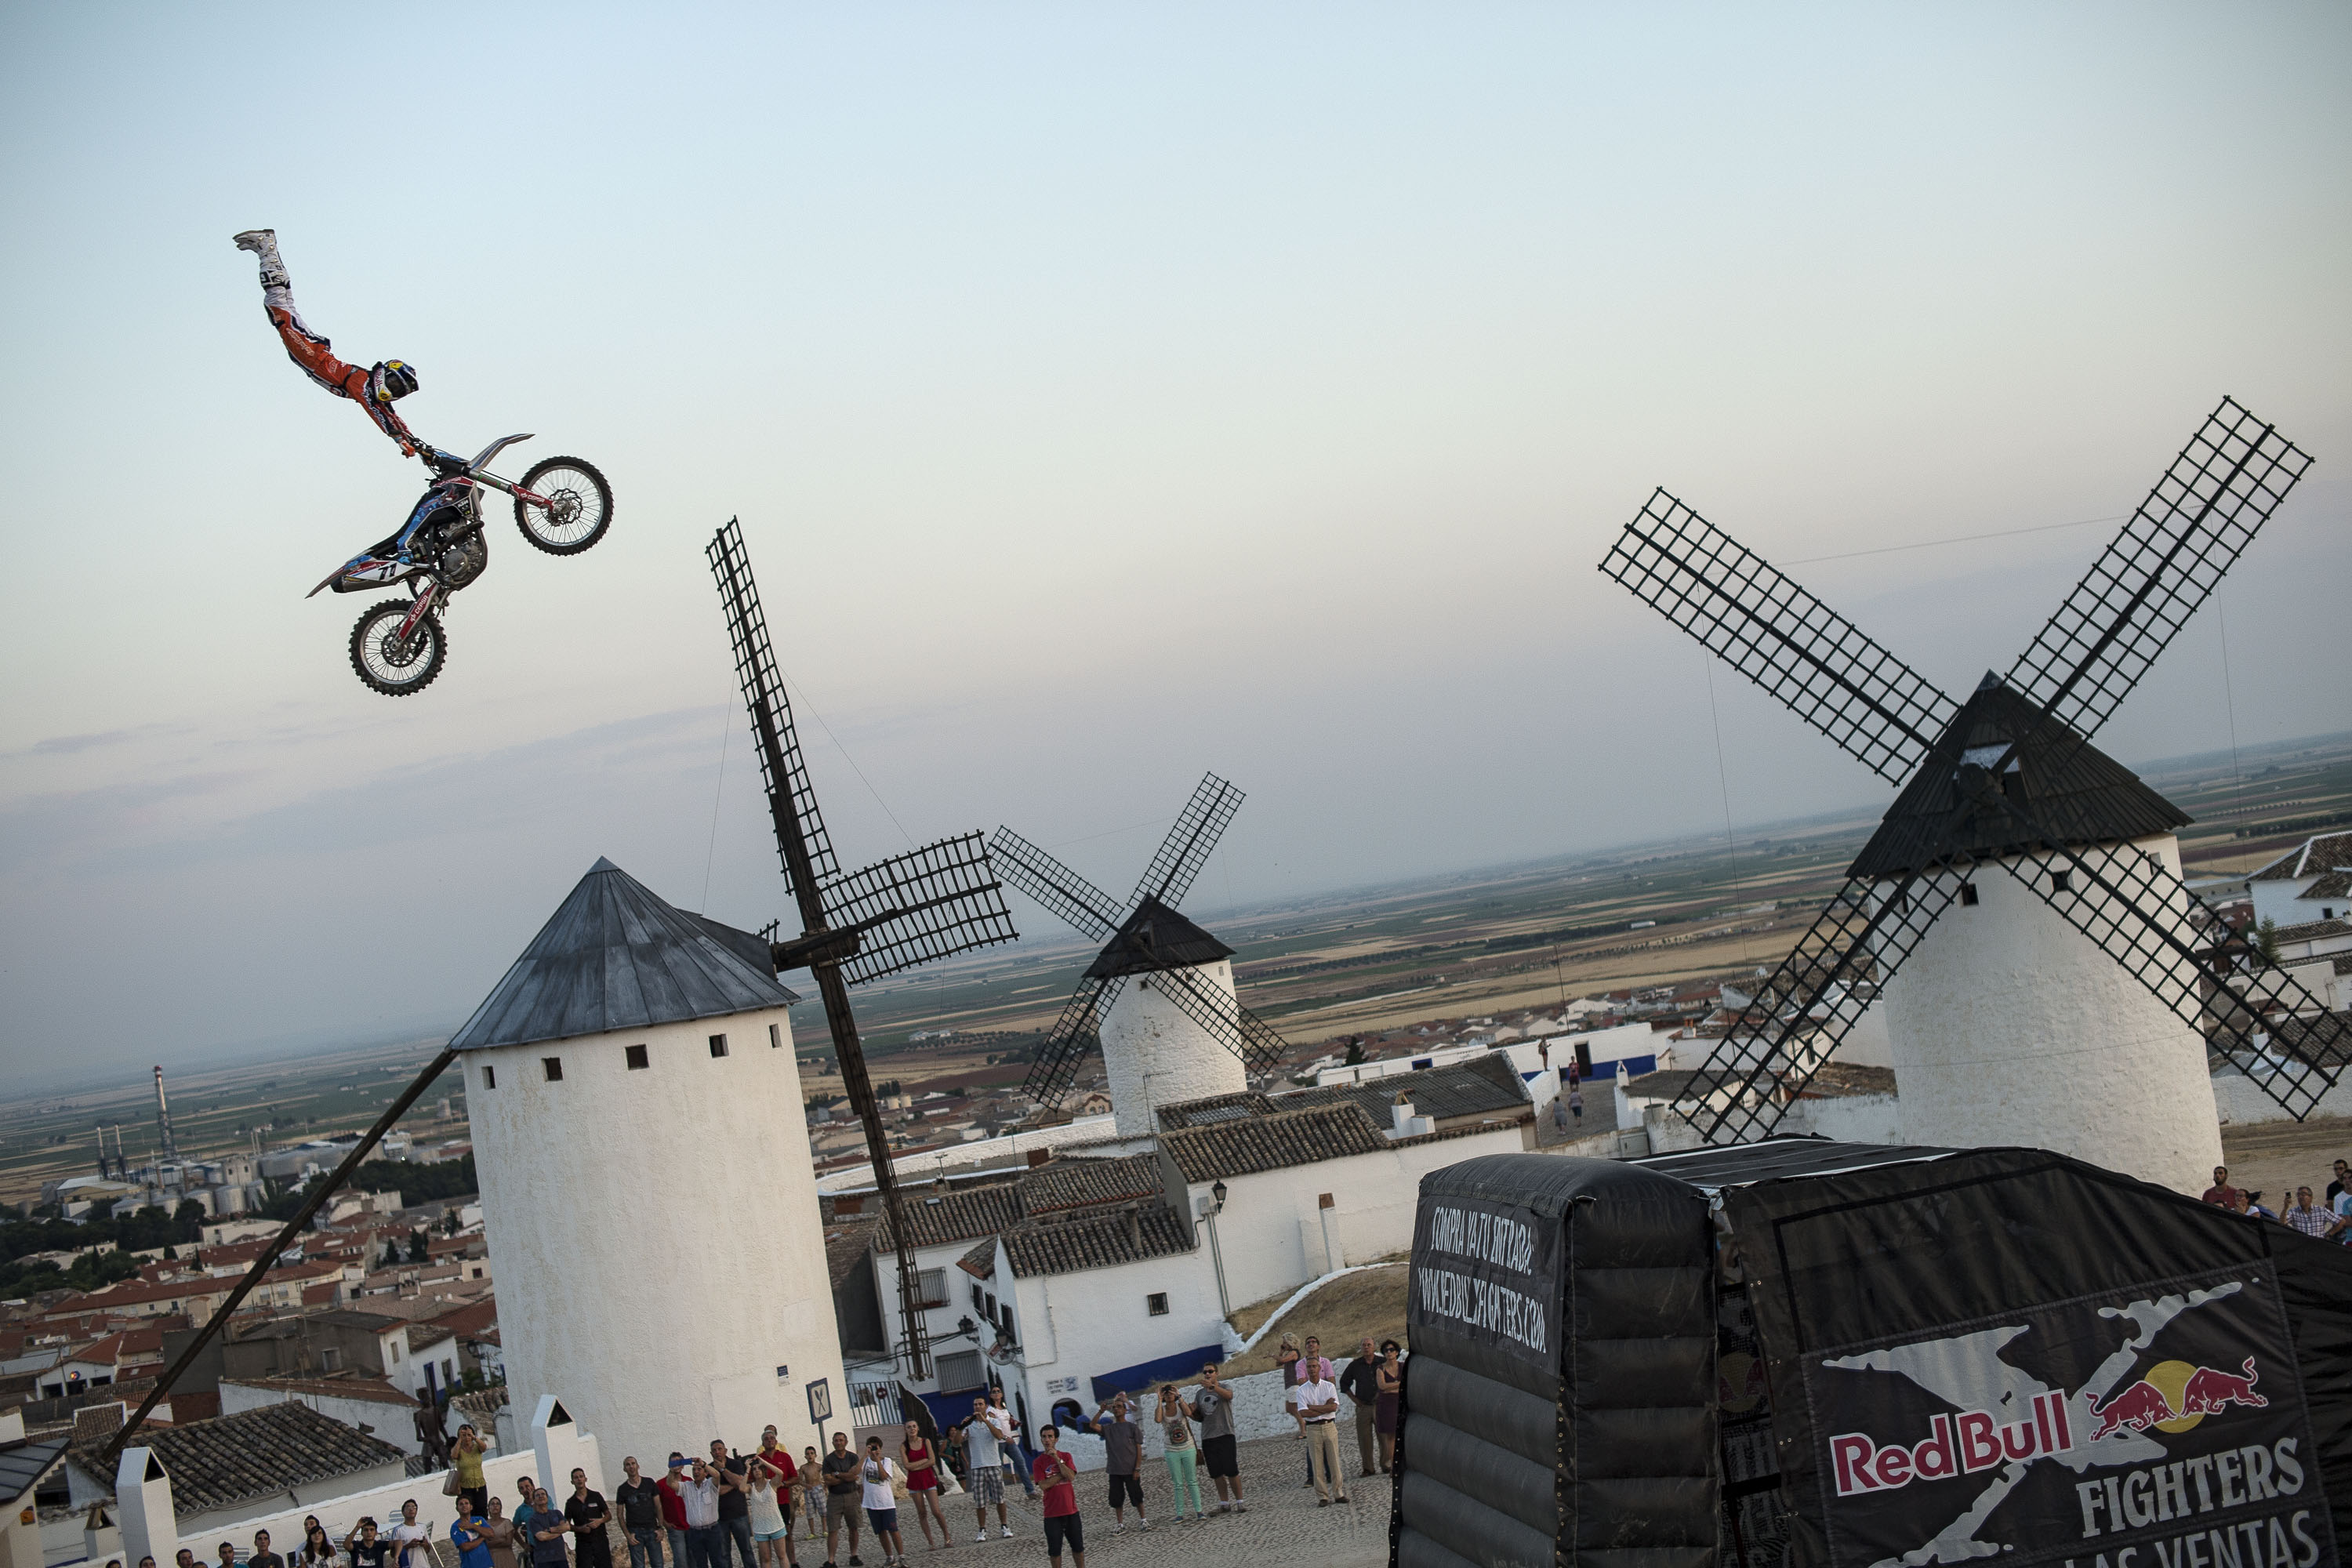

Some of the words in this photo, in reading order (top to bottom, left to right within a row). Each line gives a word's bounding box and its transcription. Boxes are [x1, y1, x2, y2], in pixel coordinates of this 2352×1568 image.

[527, 494, 546, 503] CEPSA
[415, 594, 428, 615] CEPSA
[1431, 1206, 1465, 1255] COMPRA
[1475, 1212, 1491, 1261] TU
[1831, 1414, 1958, 1497] Red
[1955, 1388, 2074, 1474] Bull
[2075, 1437, 2305, 1538] FIGHTERS
[2154, 1510, 2320, 1568] VENTAS
